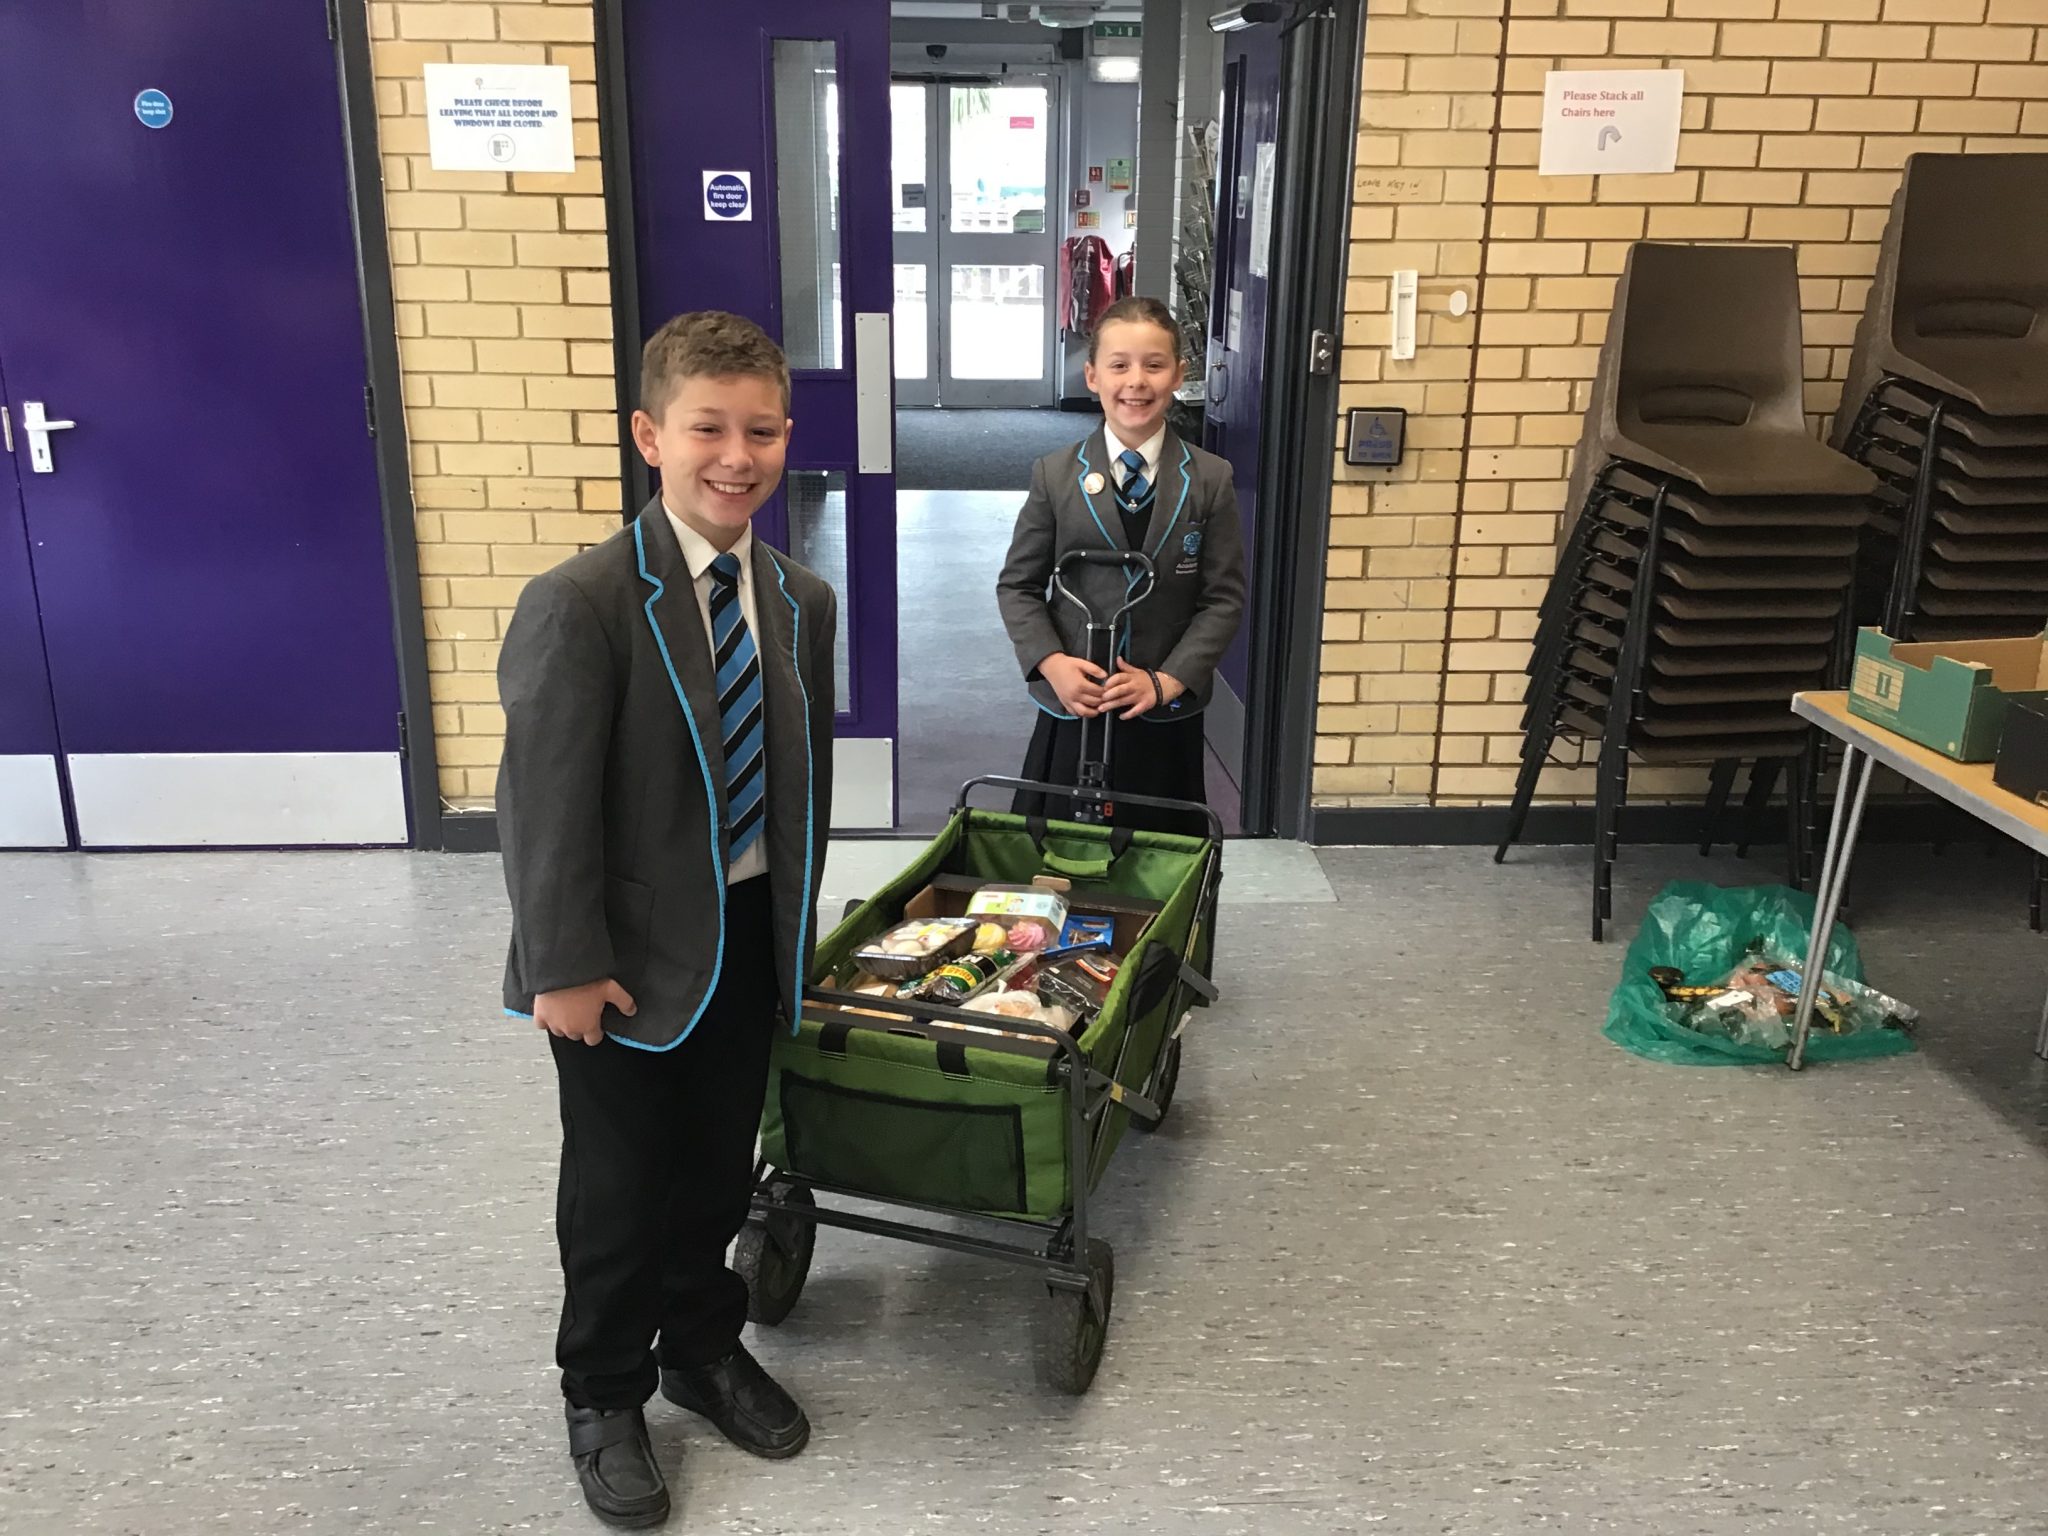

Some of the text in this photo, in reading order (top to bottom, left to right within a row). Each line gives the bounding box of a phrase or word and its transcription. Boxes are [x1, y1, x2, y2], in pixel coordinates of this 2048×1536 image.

[1563, 90, 1644, 101] Please Stack all
[454, 98, 482, 107] PLEASE
[484, 98, 510, 107] CHECK
[439, 108, 558, 118] LEAVING THAT ALL DOORS AND
[1561, 107, 1616, 117] Chairs here
[454, 119, 495, 128] WINDOWS
[496, 120, 511, 128] ARE
[710, 201, 727, 209] keep
